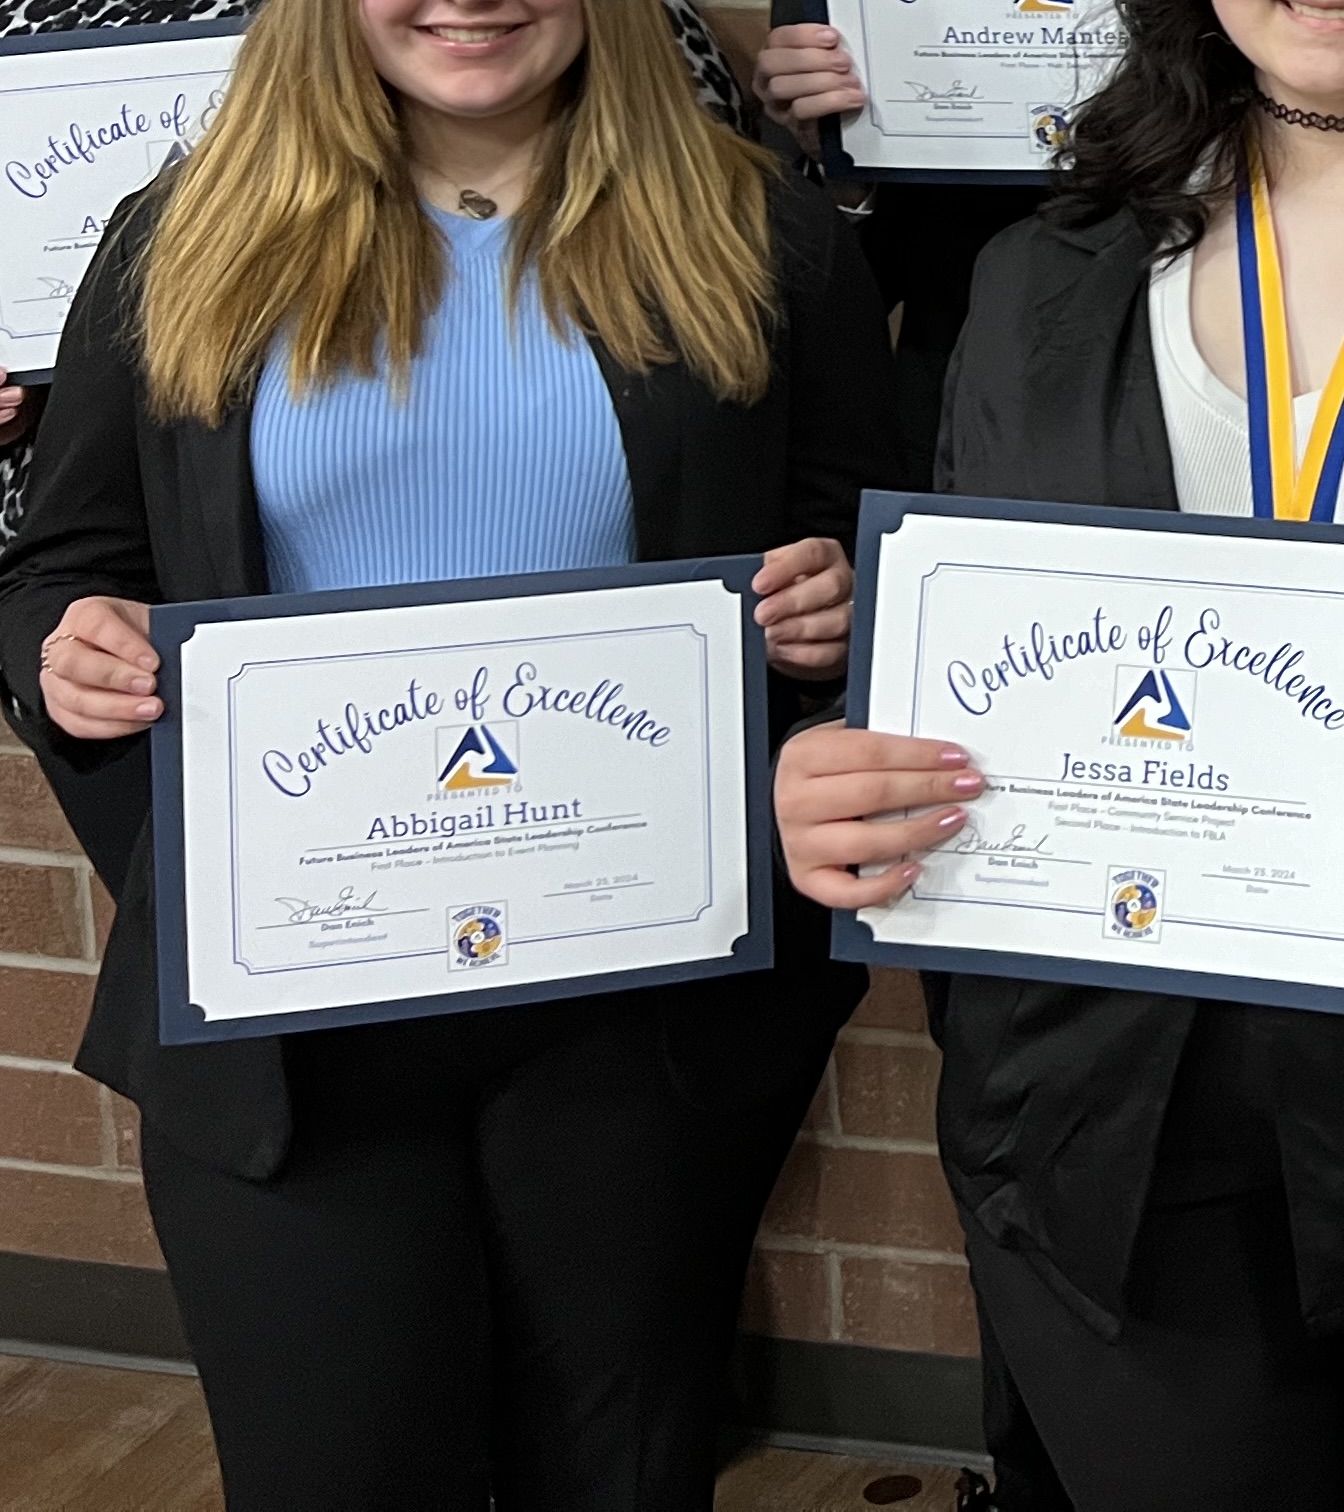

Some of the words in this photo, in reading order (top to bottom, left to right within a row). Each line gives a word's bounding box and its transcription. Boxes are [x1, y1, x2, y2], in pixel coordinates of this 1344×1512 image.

[943, 26, 1034, 44] Andrew
[6, 104, 151, 198] Certificate
[161, 93, 190, 136] of
[946, 607, 1128, 716] Certificate
[1138, 606, 1173, 663] of
[262, 679, 443, 798] Certificate
[454, 666, 492, 720] of
[503, 662, 671, 748] Excellence
[1101, 735, 1171, 750] PRESENTED
[1178, 741, 1194, 752] TO
[426, 787, 499, 801] PRESENTED
[506, 782, 523, 793] TO
[1061, 753, 1132, 783] Jessa
[1142, 760, 1229, 791] Fields
[366, 805, 494, 839] Abbigail
[504, 798, 582, 825] Hunt
[1009, 784, 1054, 795] Business
[1057, 788, 1098, 799] Leaders
[1101, 791, 1112, 801] of
[1114, 793, 1158, 805] America
[1161, 796, 1188, 807] State
[1191, 799, 1248, 815] Leadership
[1251, 805, 1312, 819] Conference
[299, 856, 333, 865] Future
[336, 851, 384, 862] Business
[386, 845, 429, 857] Leaders
[432, 842, 443, 852] of
[446, 839, 491, 850] America
[494, 835, 523, 845] State
[525, 828, 584, 841] Leadership
[586, 821, 648, 834] Conference
